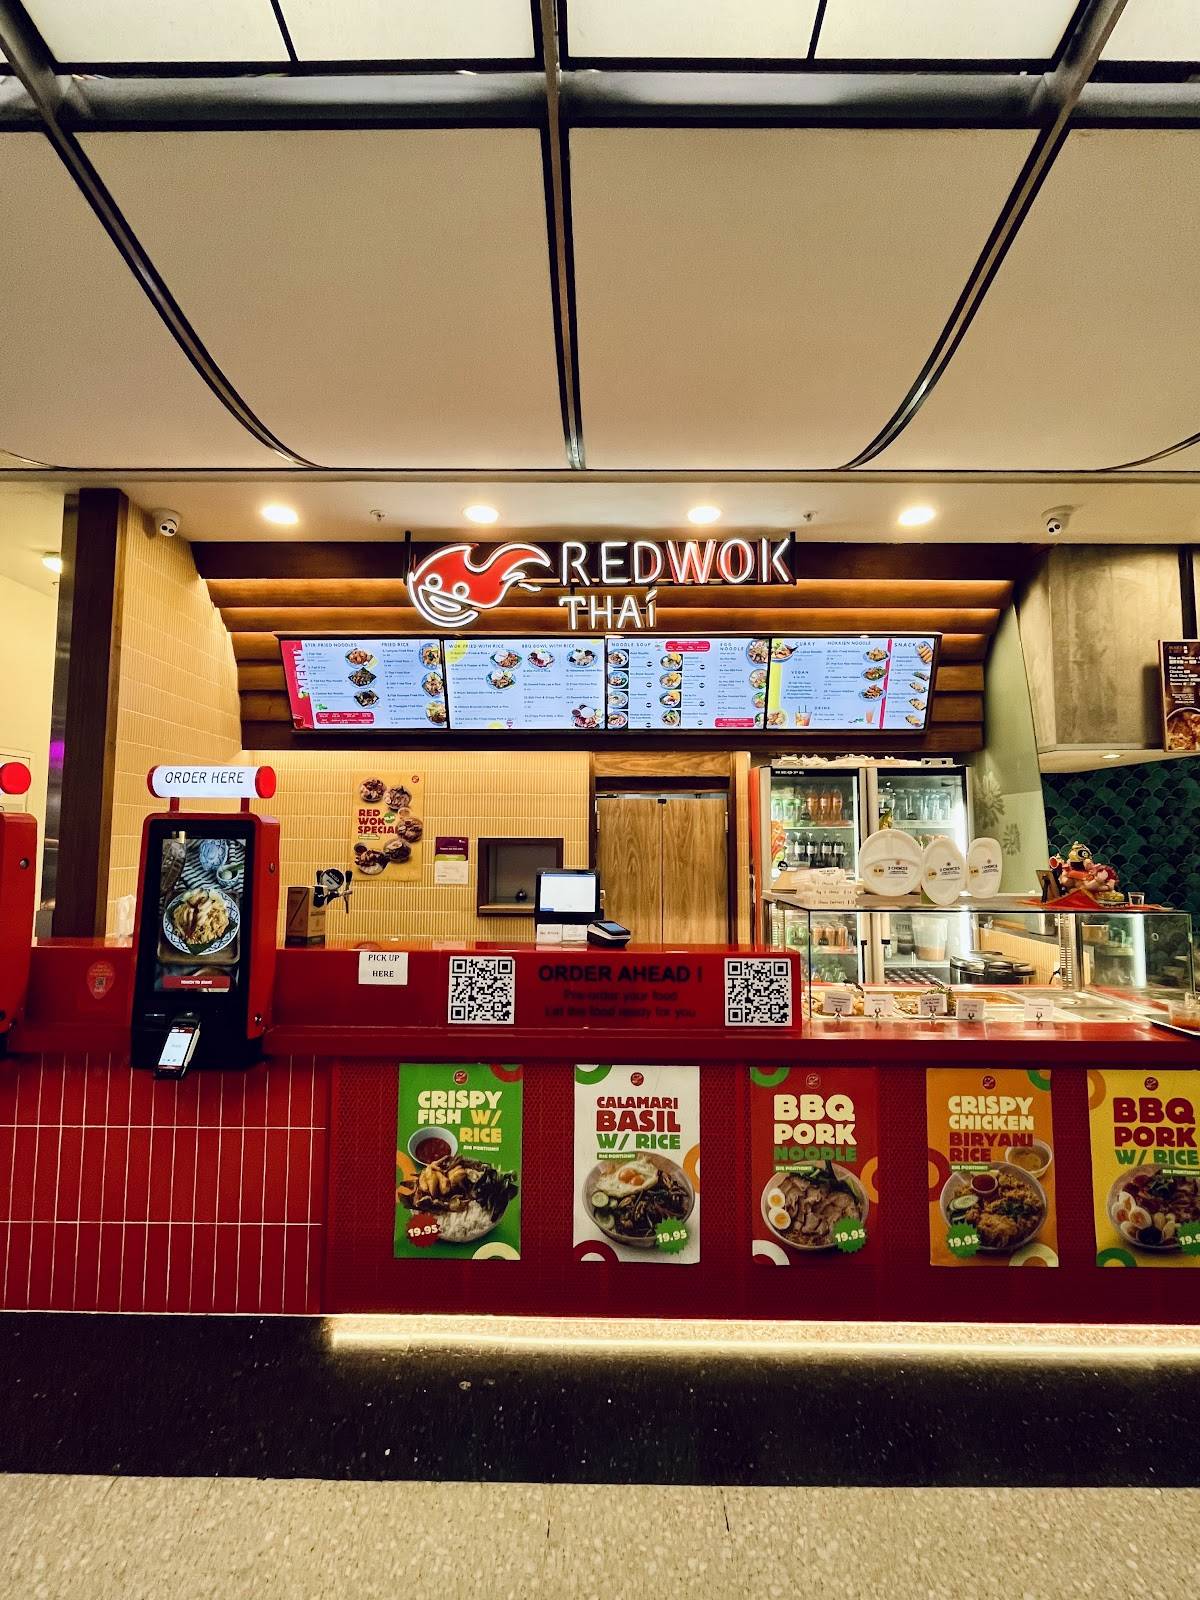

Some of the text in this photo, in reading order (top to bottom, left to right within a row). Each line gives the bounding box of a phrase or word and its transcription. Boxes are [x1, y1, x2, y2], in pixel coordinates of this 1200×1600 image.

[165, 772, 245, 784] ORDER HERE
[538, 965, 612, 982] ORDER
[617, 965, 690, 982] AHEAD
[418, 1090, 503, 1109] CRISPY
[596, 1096, 679, 1109] CALAMARI
[948, 1095, 1034, 1115] CRISPY
[774, 1094, 856, 1122] BBQ
[1113, 1097, 1196, 1124] BBQ
[418, 1109, 502, 1126] FISH W/
[596, 1110, 681, 1133] BASIL
[949, 1115, 1035, 1131] CHICKEN
[460, 1127, 502, 1143] RICE
[596, 1133, 680, 1151] W/ RICE
[774, 1123, 857, 1145] PORK
[950, 1132, 1033, 1147] BIRYANI
[1114, 1126, 1197, 1148] PORK
[774, 1147, 857, 1162] NOODLE
[950, 1148, 991, 1162] RICE
[1115, 1150, 1199, 1166] W/ RICE
[408, 1225, 438, 1238] 19.95
[657, 1229, 687, 1243] 19.95
[835, 1229, 865, 1243] 19.95
[1179, 1233, 1200, 1245] 19.9
[949, 1235, 979, 1248] 19.95
